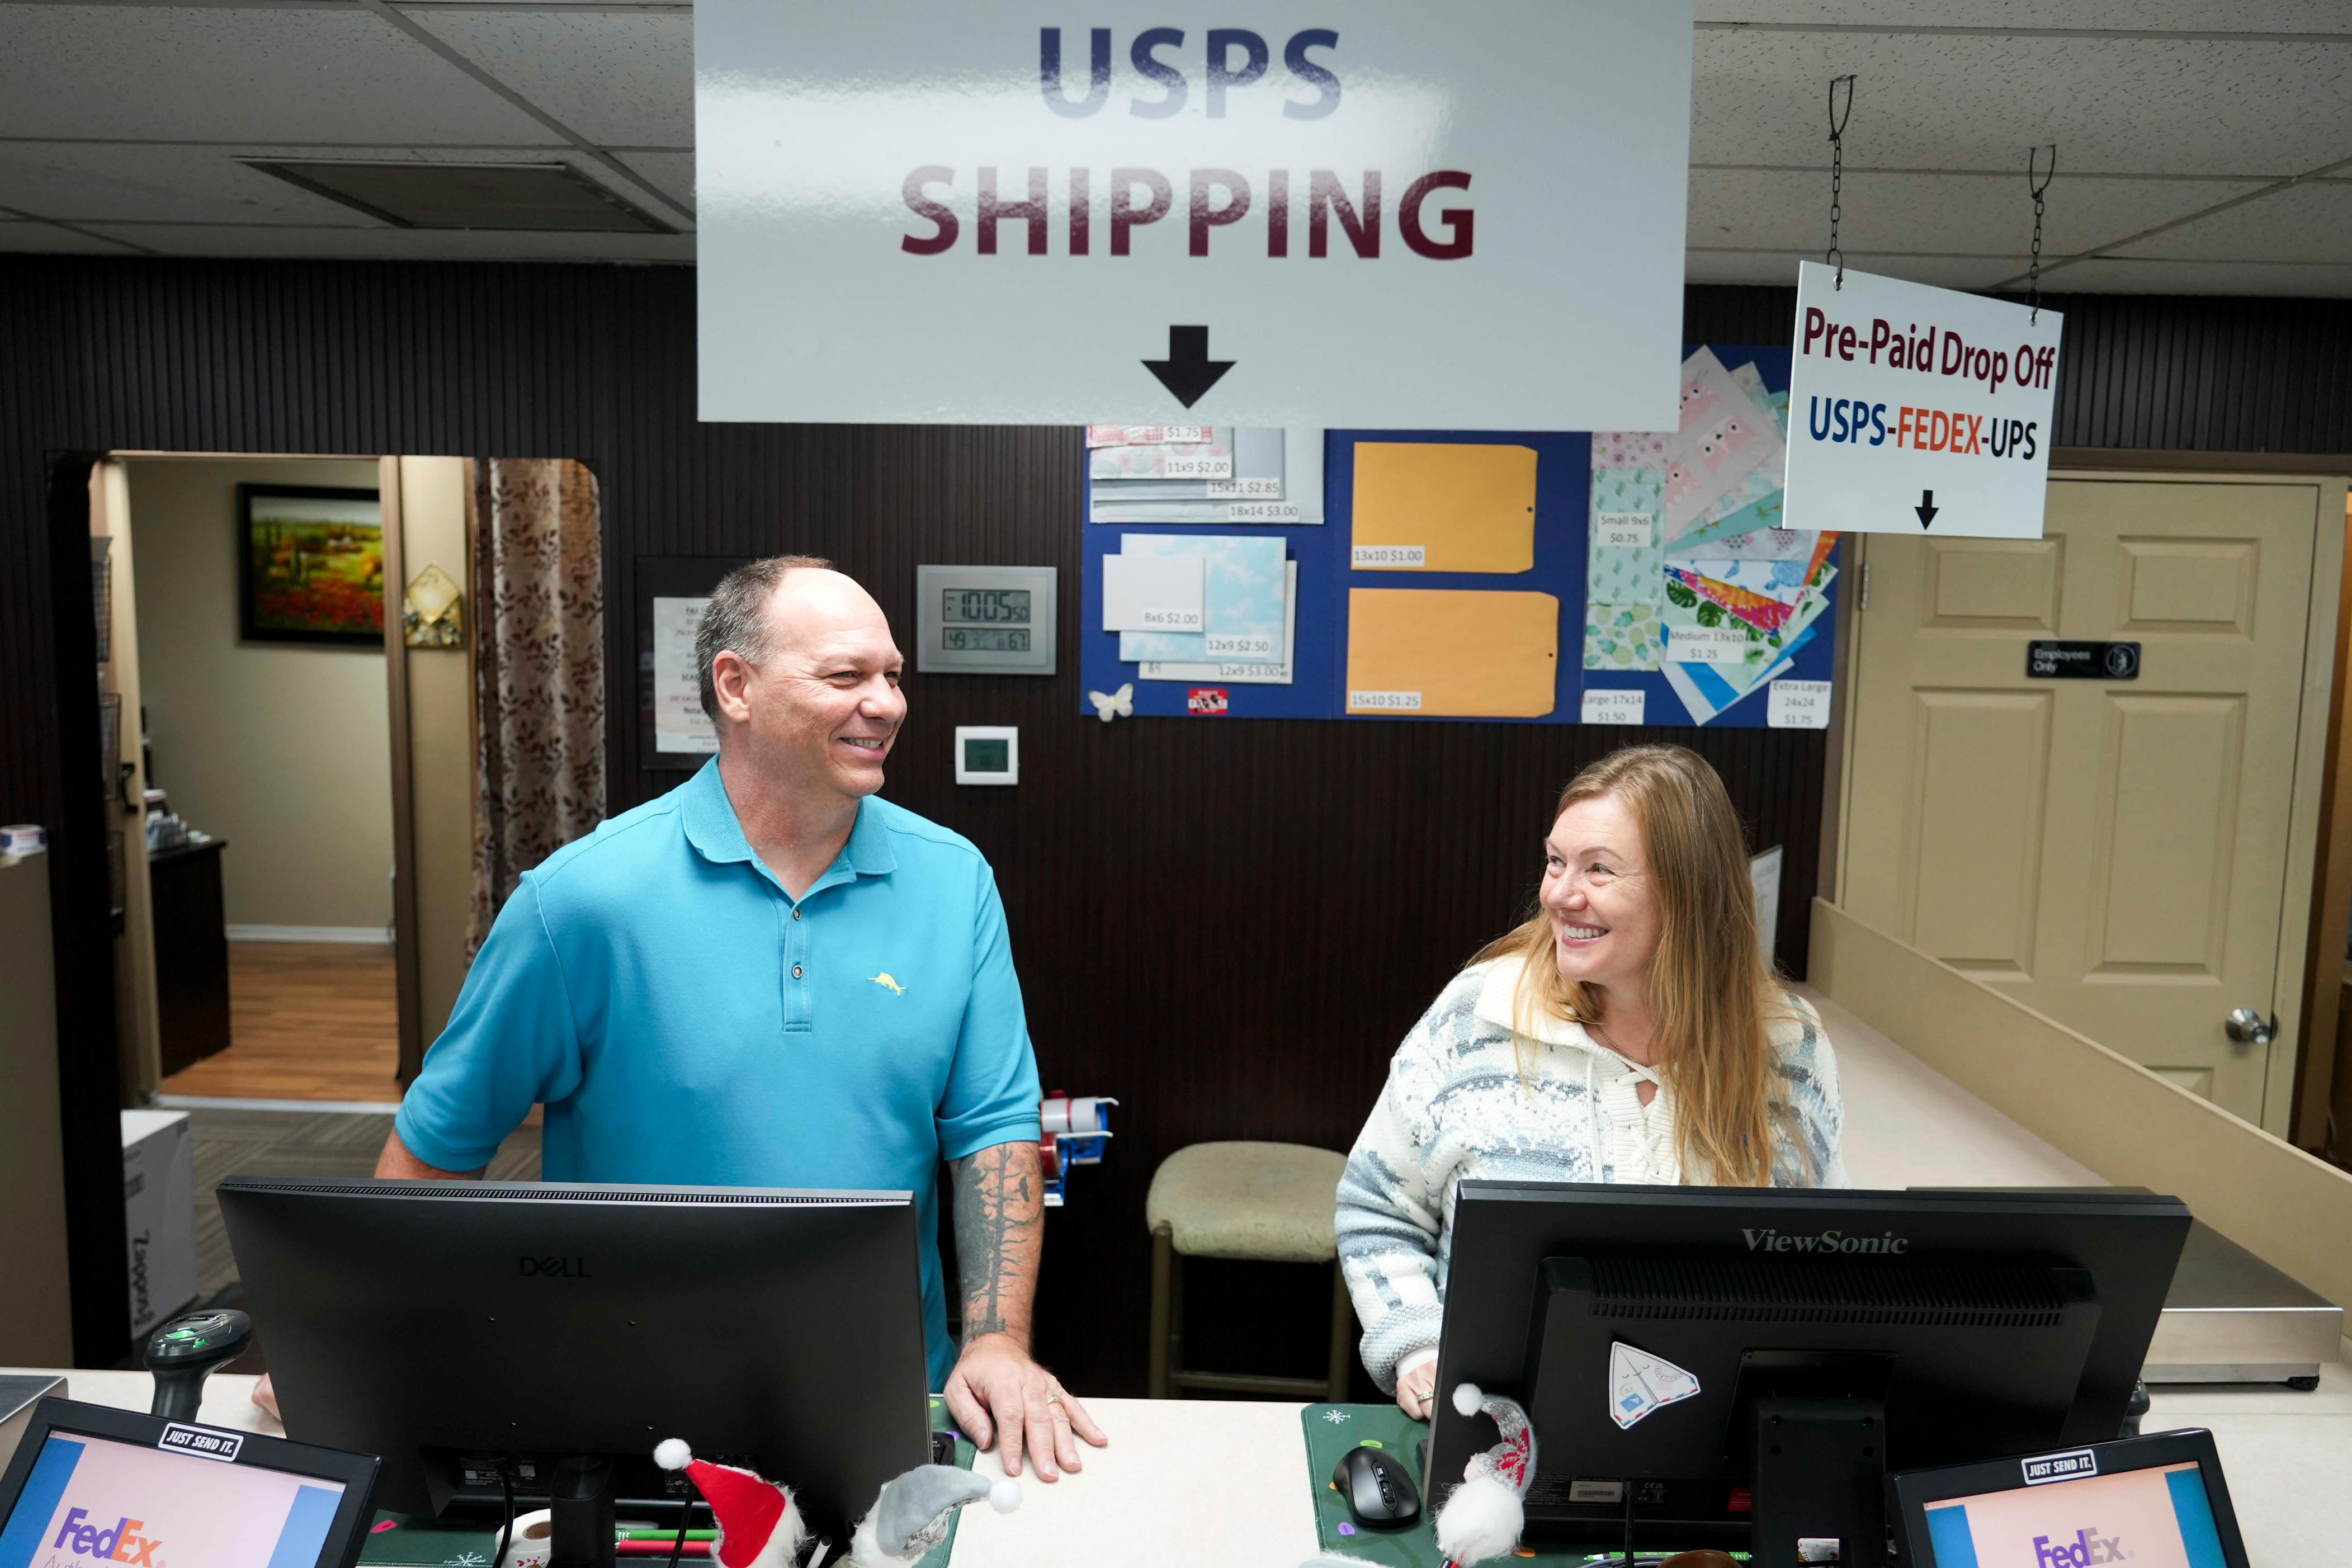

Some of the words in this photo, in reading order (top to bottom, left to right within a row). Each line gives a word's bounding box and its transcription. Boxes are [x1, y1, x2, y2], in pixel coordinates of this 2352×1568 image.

[1040, 26, 1343, 121] USPS
[900, 165, 1475, 261] SHIPPING
[1803, 307, 1936, 372] Pre-Paid
[1941, 331, 2009, 394] Drop
[2015, 344, 2056, 390] Off
[1168, 427, 1200, 438] $1.75
[1809, 395, 2038, 460] USPS-FEDEX-UPS
[1168, 462, 1194, 473] 11x9
[1197, 461, 1230, 474] $2.00
[1211, 483, 1244, 493] 15x11
[1248, 482, 1279, 494] $2.85
[1231, 506, 1263, 516] 18x14
[1267, 506, 1299, 517] $3.00
[1600, 515, 1629, 526] Small
[1354, 550, 1388, 561] 13x10
[1391, 550, 1422, 562] $1.00
[1144, 613, 1164, 623] 8x6
[1167, 612, 1198, 625] $2.00
[1670, 631, 1711, 642] Medium
[1208, 640, 1235, 651] 12x9
[1237, 640, 1269, 653] $2.50
[2034, 649, 2091, 661] Employees
[1219, 665, 1245, 676] 12x9
[1248, 665, 1279, 677] $3.00
[2033, 660, 2058, 673] Only
[1352, 695, 1385, 706] 15x10
[1388, 695, 1419, 707] $1.25
[1741, 1228, 1909, 1254] ViewSonic
[519, 1255, 593, 1278] DELL
[166, 1430, 195, 1446] JUST
[191, 1435, 220, 1451] SEND
[219, 1441, 234, 1454] IT.
[2029, 1462, 2051, 1477] JUST
[2053, 1458, 2077, 1473] SEND
[2079, 1457, 2091, 1469] IT.
[53, 1506, 163, 1567] FedEx
[2032, 1527, 2126, 1568] FedEx
